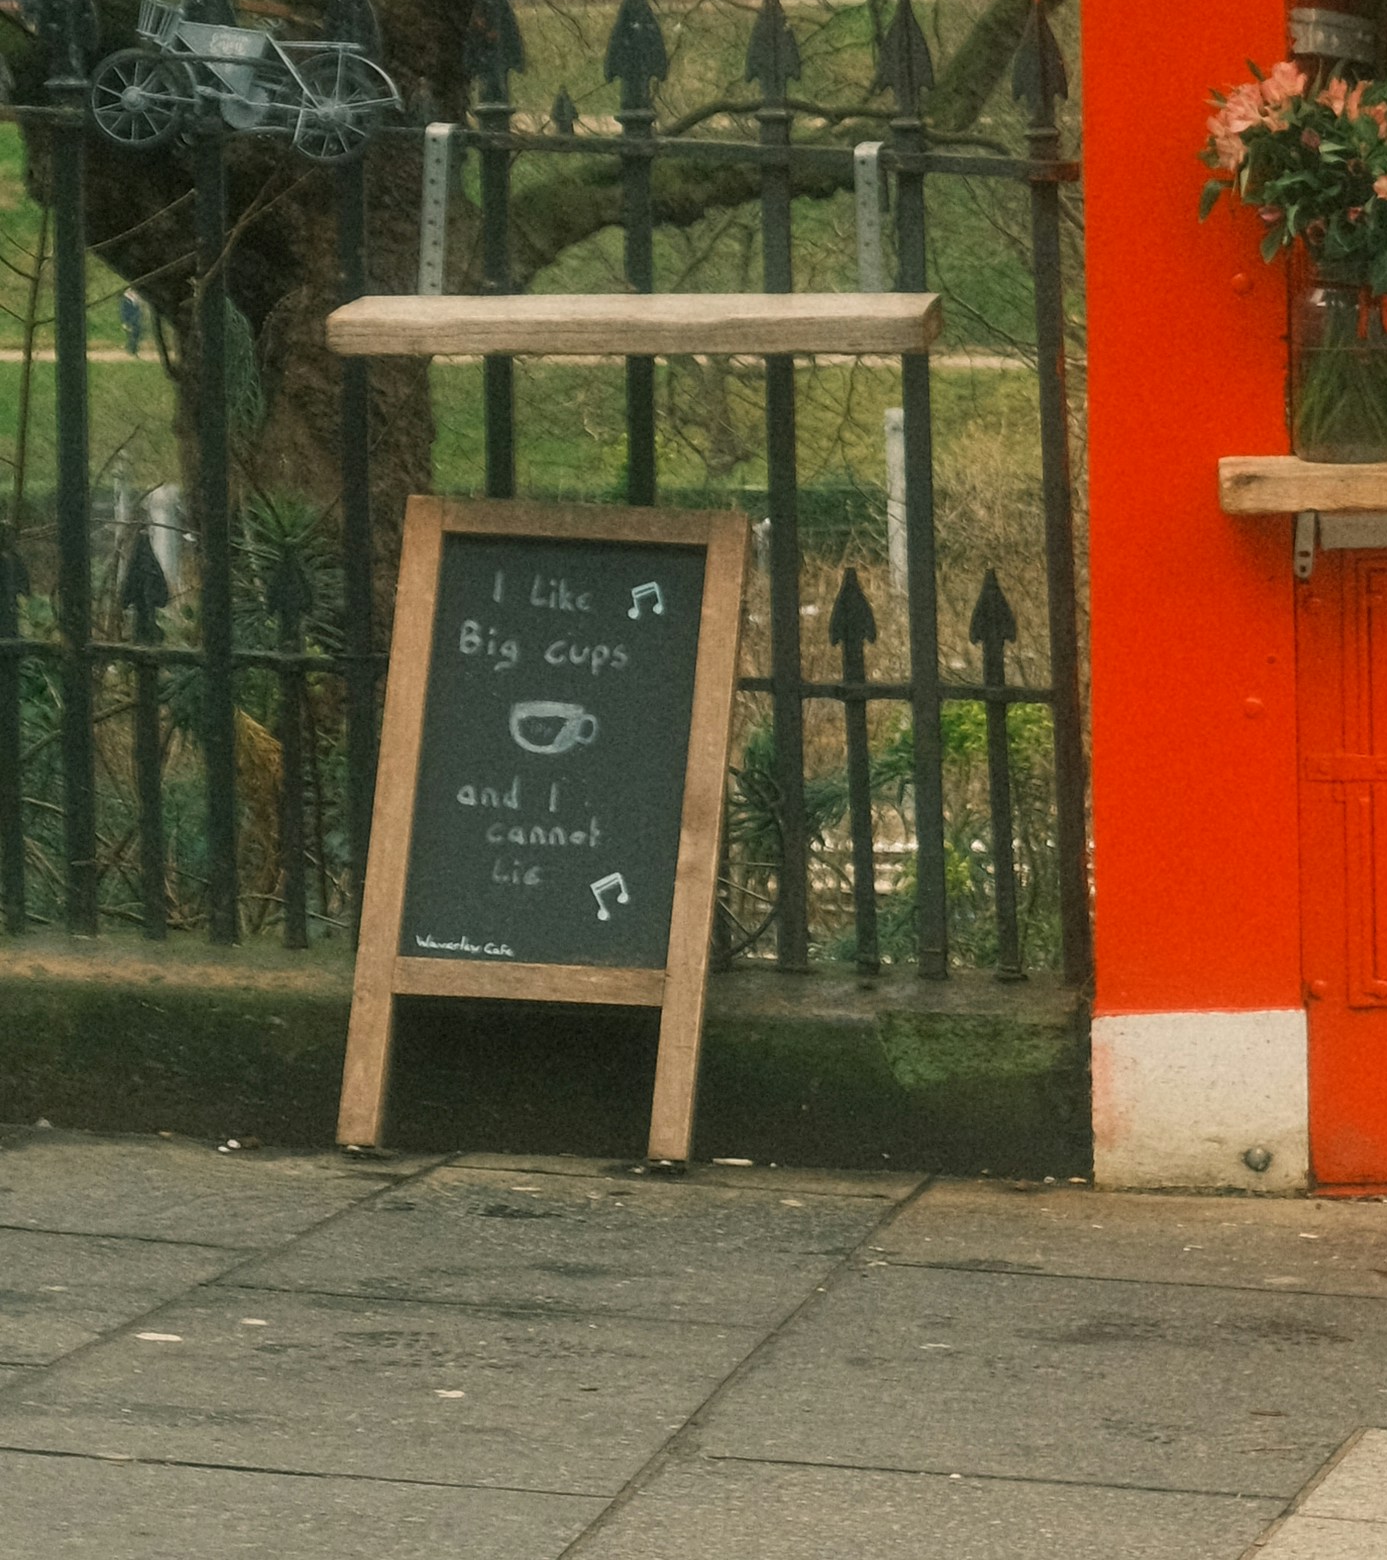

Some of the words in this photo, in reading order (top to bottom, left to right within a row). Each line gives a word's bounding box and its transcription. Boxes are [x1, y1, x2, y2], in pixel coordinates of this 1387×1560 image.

[492, 569, 502, 603] I
[529, 575, 592, 612] Like
[459, 620, 519, 671] Big
[456, 776, 519, 811] and
[548, 782, 557, 813] I
[486, 817, 600, 848] cannot
